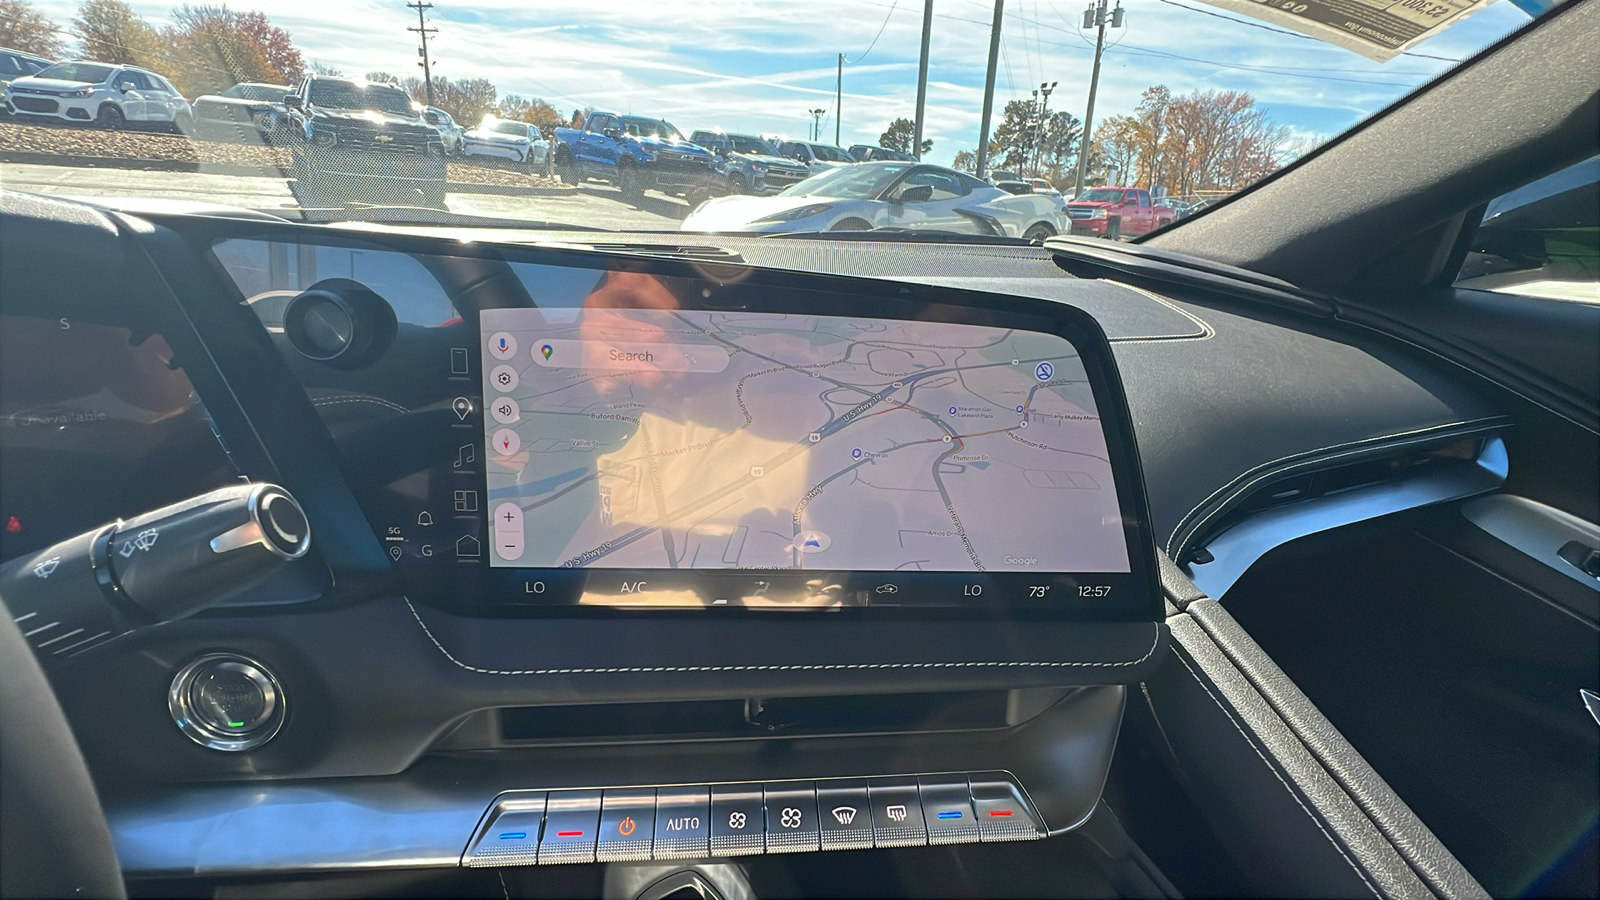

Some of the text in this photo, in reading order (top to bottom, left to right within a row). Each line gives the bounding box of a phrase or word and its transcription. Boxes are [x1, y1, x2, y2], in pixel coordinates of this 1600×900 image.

[609, 349, 654, 362] Search
[748, 369, 766, 378] Market
[856, 401, 873, 413] Hwy
[872, 393, 882, 403] 19
[590, 412, 615, 420] Buford
[615, 414, 631, 422] Dam
[571, 439, 590, 447] Vallin
[1008, 431, 1038, 448] Hutchinson
[661, 447, 686, 457] Market
[697, 440, 714, 450] Blvd
[792, 484, 823, 525] Atlanta Hwy
[388, 526, 400, 535] 5G
[947, 505, 963, 534] Veterans
[960, 533, 978, 562] Memorial
[582, 547, 601, 561] Hwy
[601, 541, 613, 551] 19
[1003, 555, 1038, 565] Google
[525, 581, 546, 594] LO
[620, 581, 647, 594] A/C
[964, 584, 982, 596] LO
[1029, 585, 1050, 597] 73°
[1077, 585, 1111, 597] 12:57
[666, 817, 699, 831] AUTO
